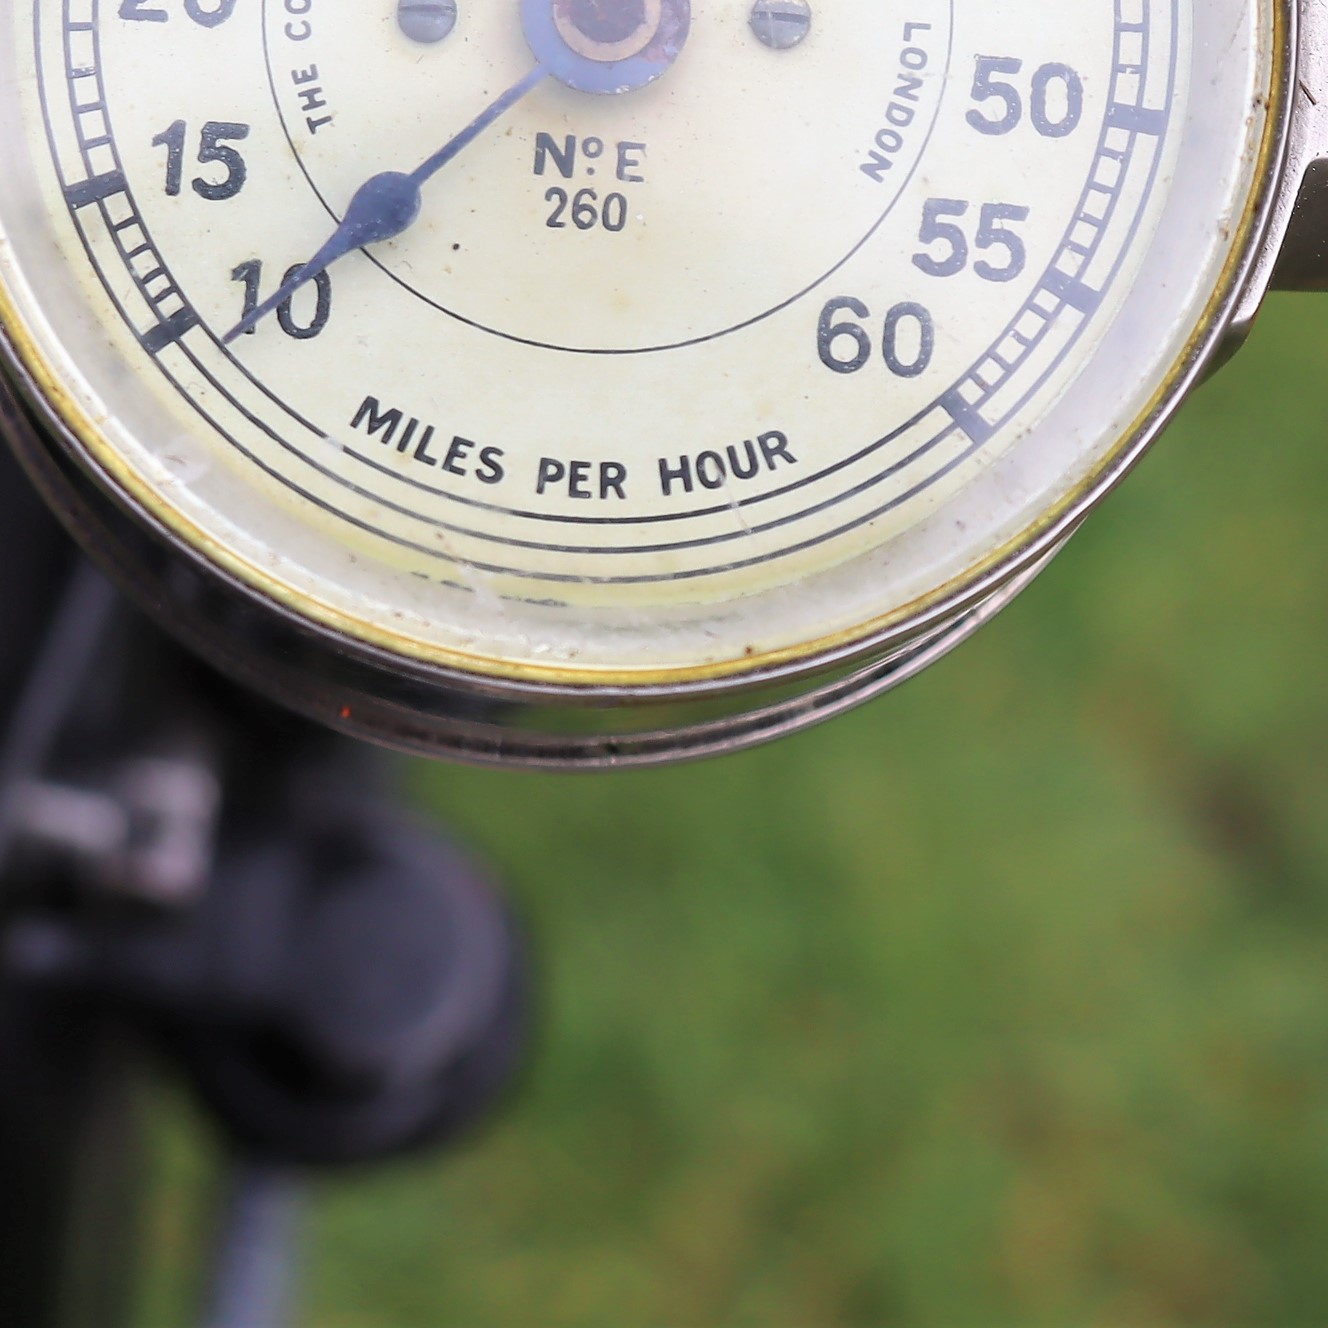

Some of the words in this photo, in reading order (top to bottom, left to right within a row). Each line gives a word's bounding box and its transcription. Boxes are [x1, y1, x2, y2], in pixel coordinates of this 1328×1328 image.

[292, 64, 332, 134] THE
[859, 22, 932, 183] LONDON
[965, 54, 1083, 138] 50
[151, 119, 250, 200] 15
[544, 186, 628, 232] 260
[912, 198, 1029, 282] 55
[230, 258, 332, 339] 10
[817, 295, 934, 378] 60
[350, 395, 504, 484] MILES
[536, 457, 627, 499] PER
[659, 429, 798, 497] HOUR
